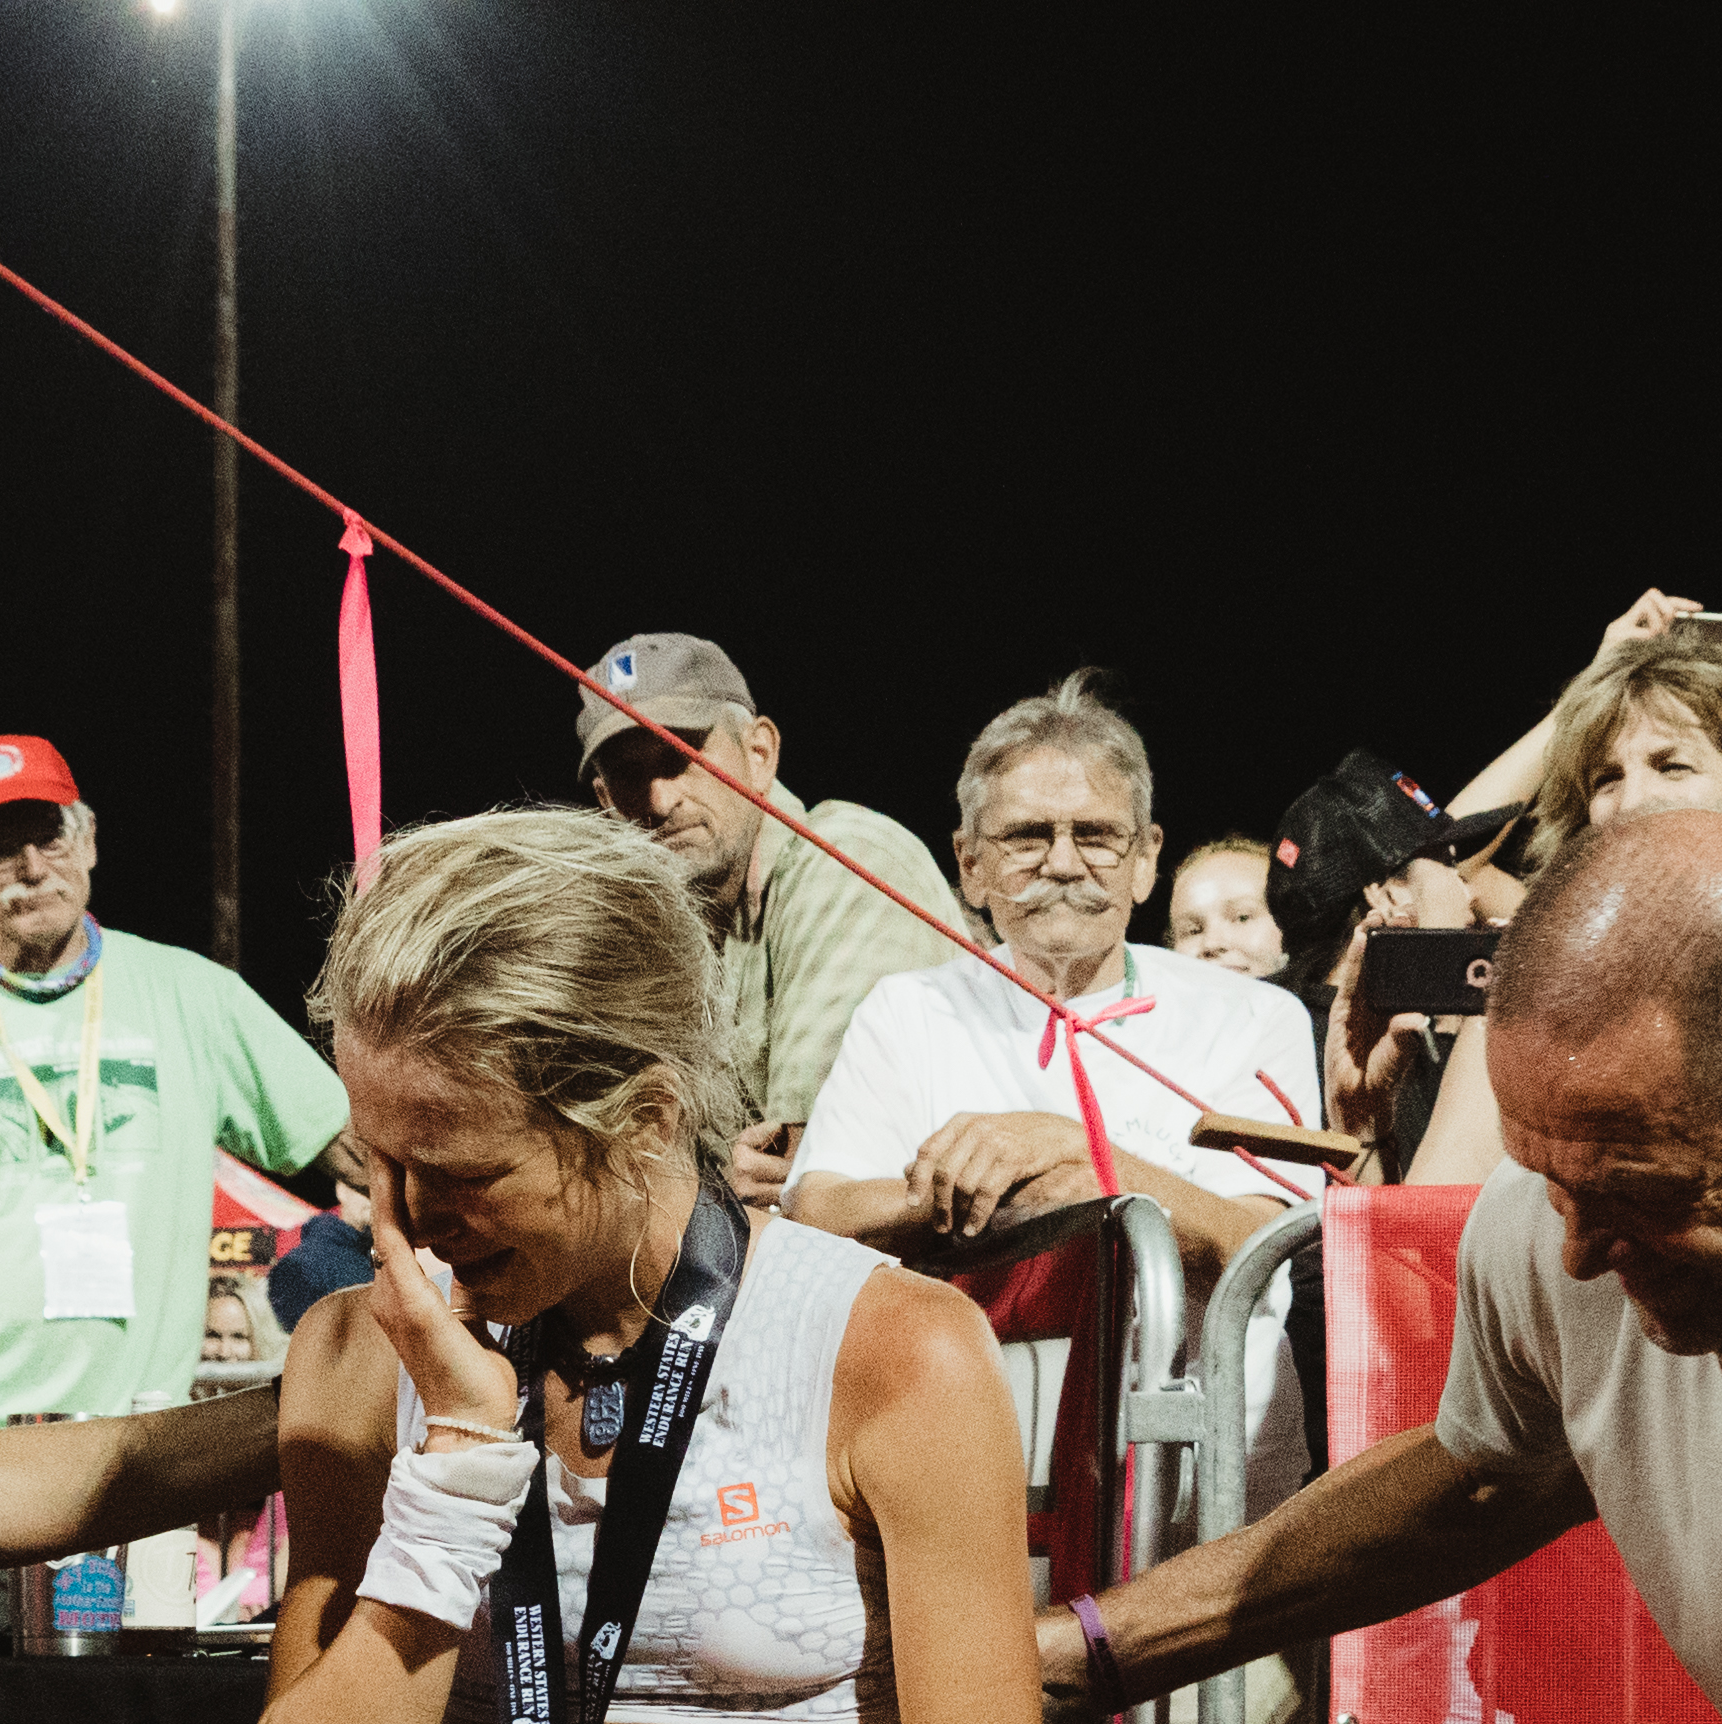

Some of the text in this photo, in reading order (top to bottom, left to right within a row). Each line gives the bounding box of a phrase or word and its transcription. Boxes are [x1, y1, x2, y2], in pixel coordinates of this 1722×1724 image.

[639, 1332, 680, 1443] WESTERN STATES
[652, 1340, 694, 1448] ENDURANCE RUN
[700, 1521, 791, 1548] salomon
[513, 1606, 535, 1716] ENDURANCE RUN
[528, 1603, 550, 1719] WESTERN STATES
